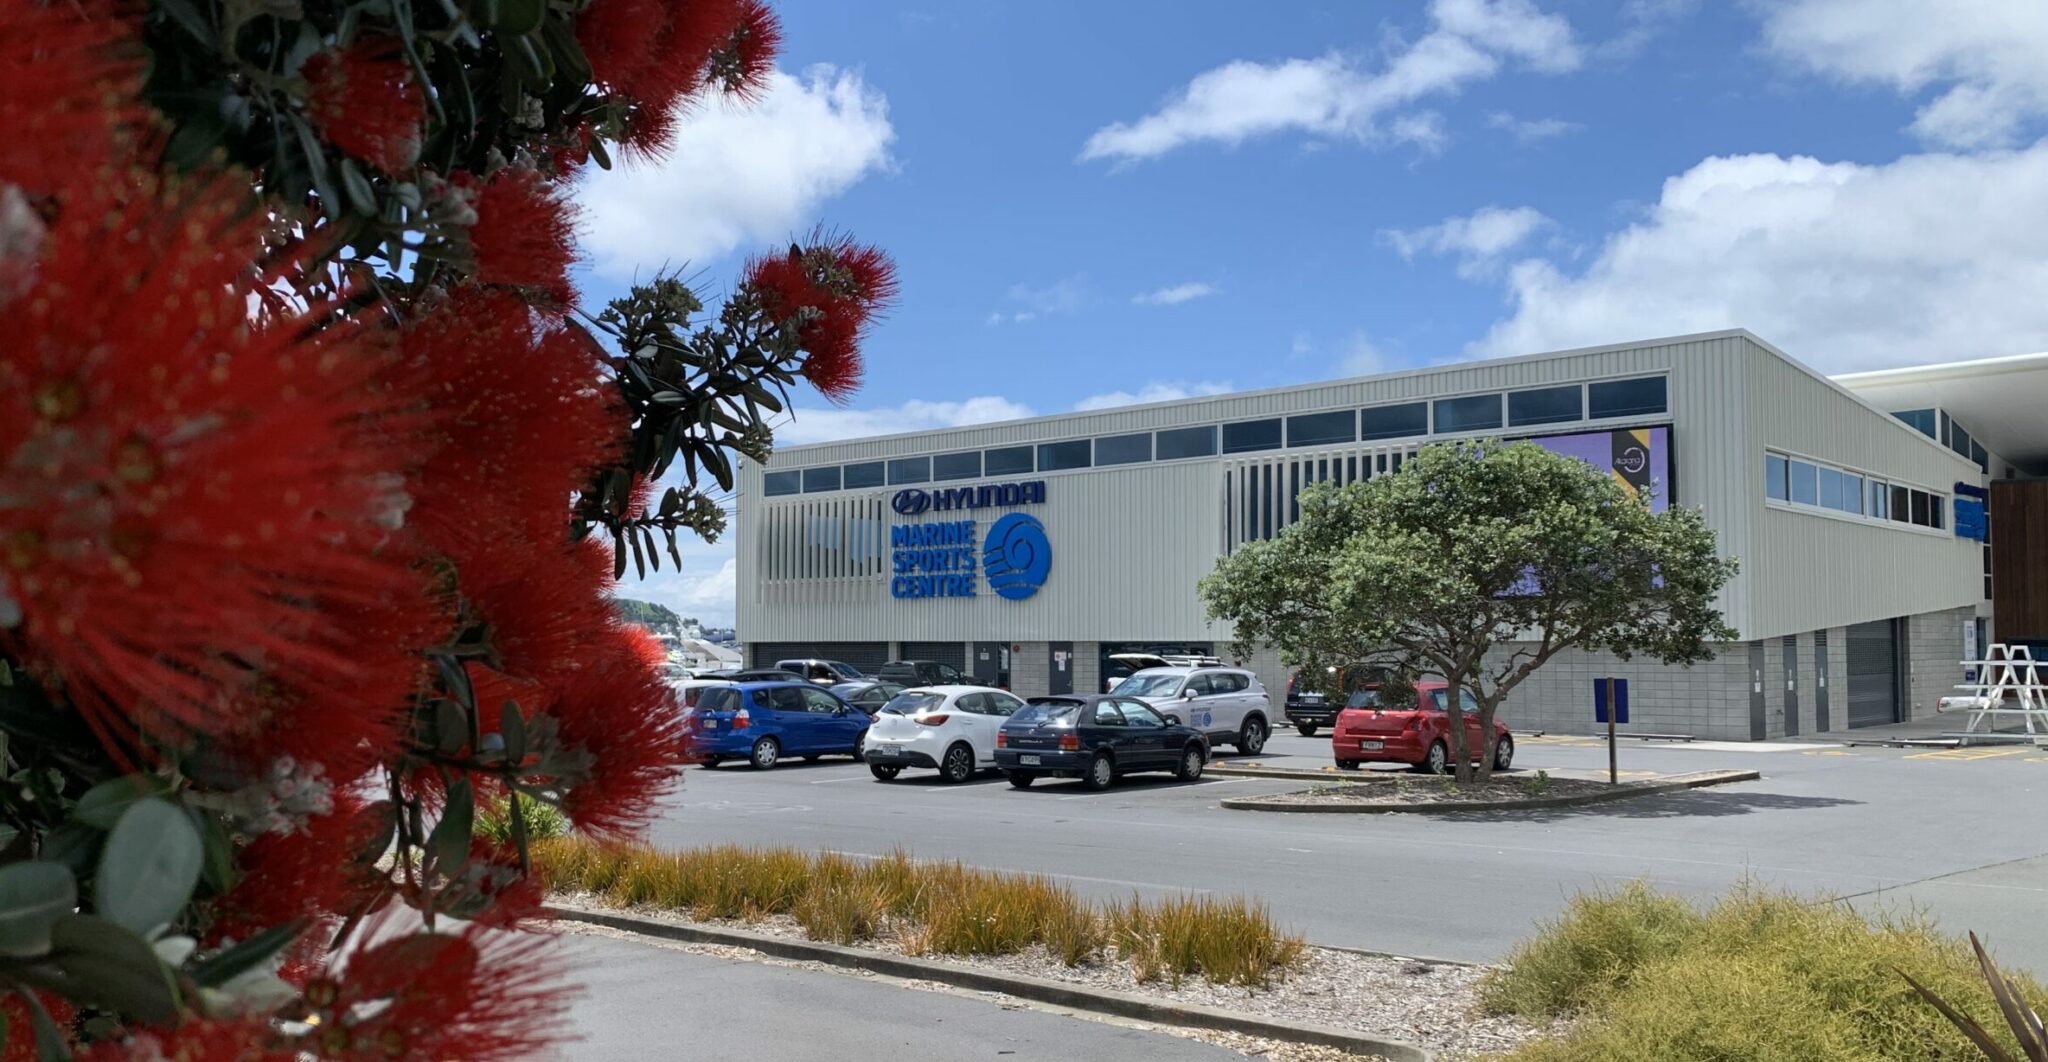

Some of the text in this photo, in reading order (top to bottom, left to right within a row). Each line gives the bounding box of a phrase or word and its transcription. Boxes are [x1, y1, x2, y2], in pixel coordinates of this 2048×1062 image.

[933, 480, 1046, 512] HYUNDAI
[891, 520, 977, 548] MARINE
[892, 547, 977, 574] SPORTS
[891, 573, 977, 599] CENTRE
